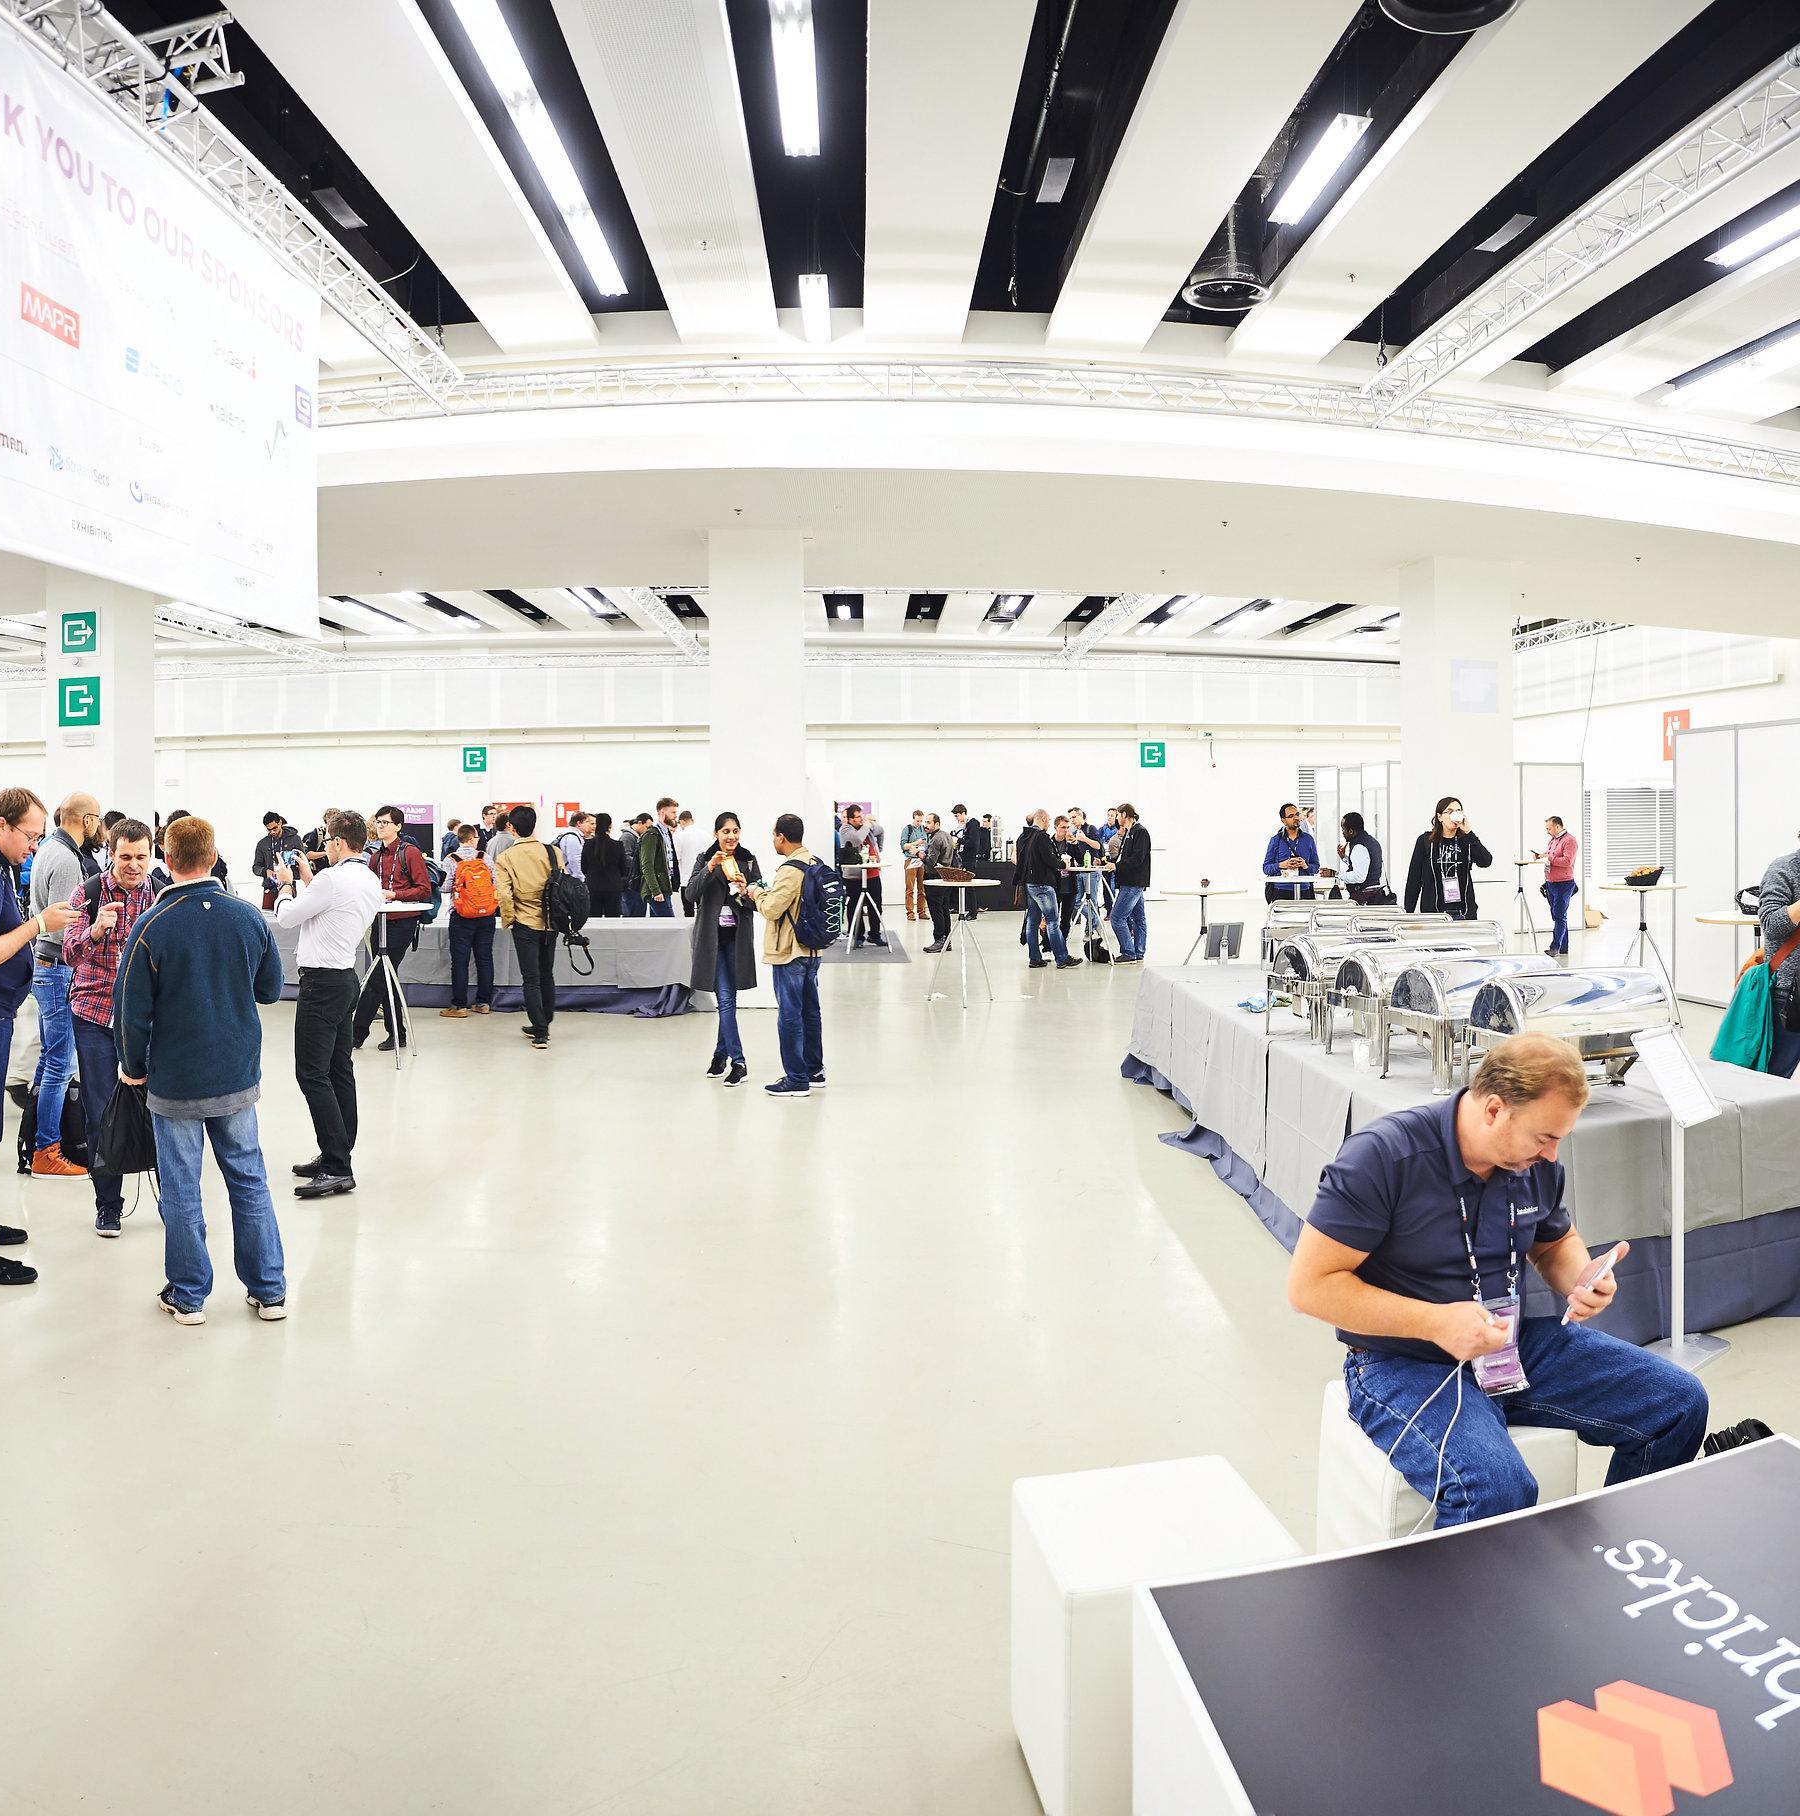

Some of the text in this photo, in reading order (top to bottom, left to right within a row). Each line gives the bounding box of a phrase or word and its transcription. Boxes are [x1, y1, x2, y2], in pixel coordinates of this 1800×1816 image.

[35, 114, 94, 196] YOU
[100, 171, 136, 226] TO
[144, 207, 194, 272] OUR
[200, 249, 303, 352] SPONSORS
[23, 290, 77, 341] MAPR
